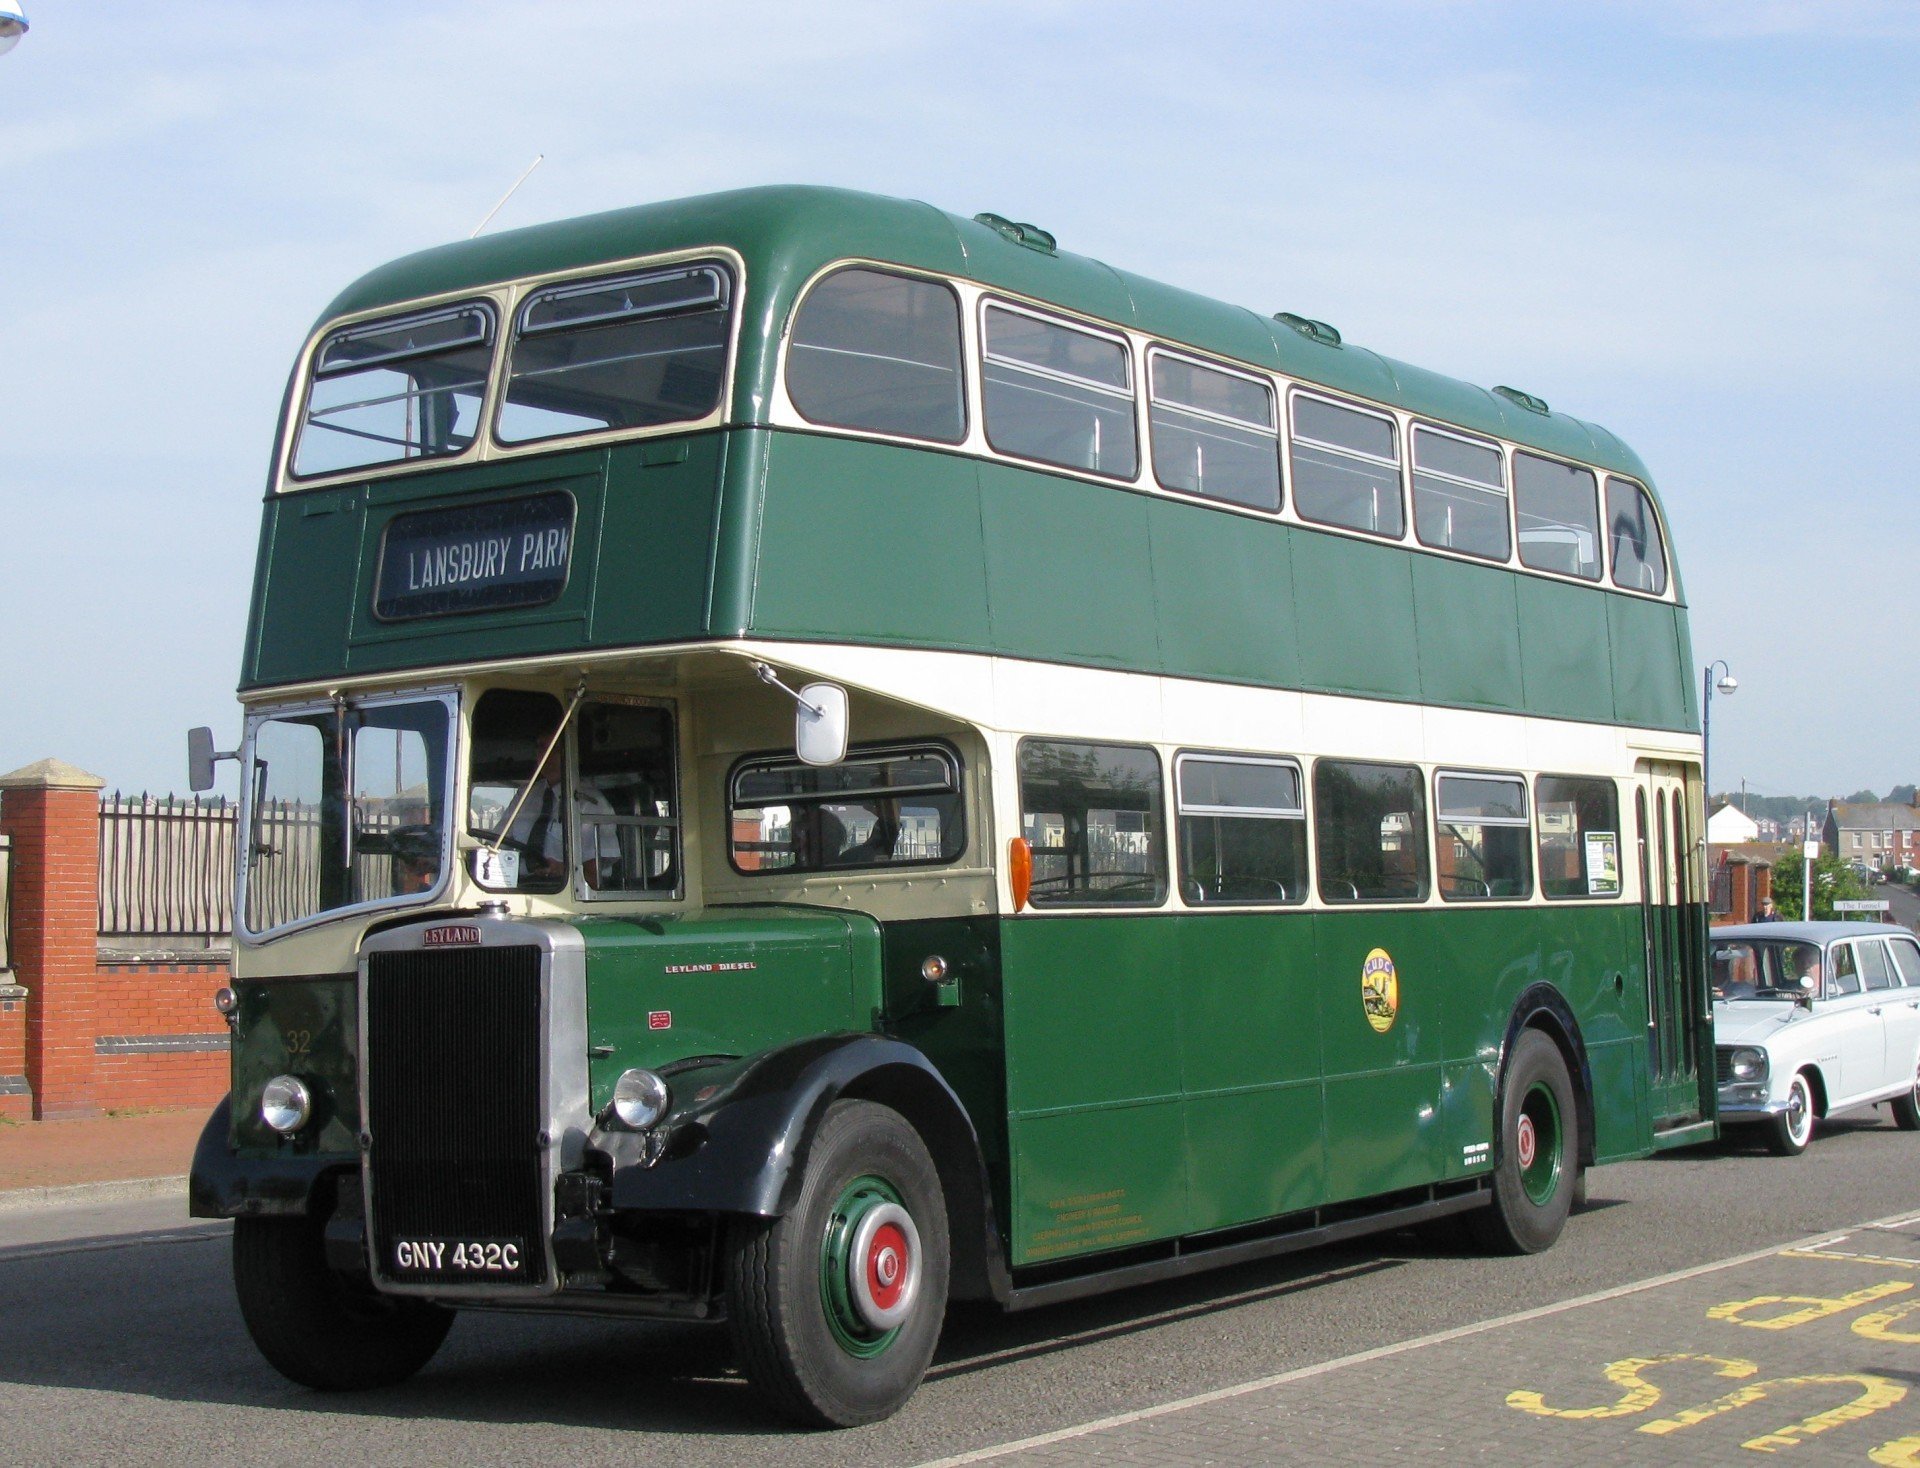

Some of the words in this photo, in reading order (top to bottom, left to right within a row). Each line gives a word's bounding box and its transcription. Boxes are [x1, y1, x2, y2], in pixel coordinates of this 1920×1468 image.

[409, 536, 512, 590] LANSBURY
[520, 527, 570, 572] PARK
[425, 927, 478, 943] LEYLAND
[665, 964, 712, 974] LEYLAND
[719, 962, 756, 971] DIESEL
[287, 1030, 311, 1053] 32
[397, 1241, 445, 1269] GNY
[452, 1242, 519, 1270] 432C
